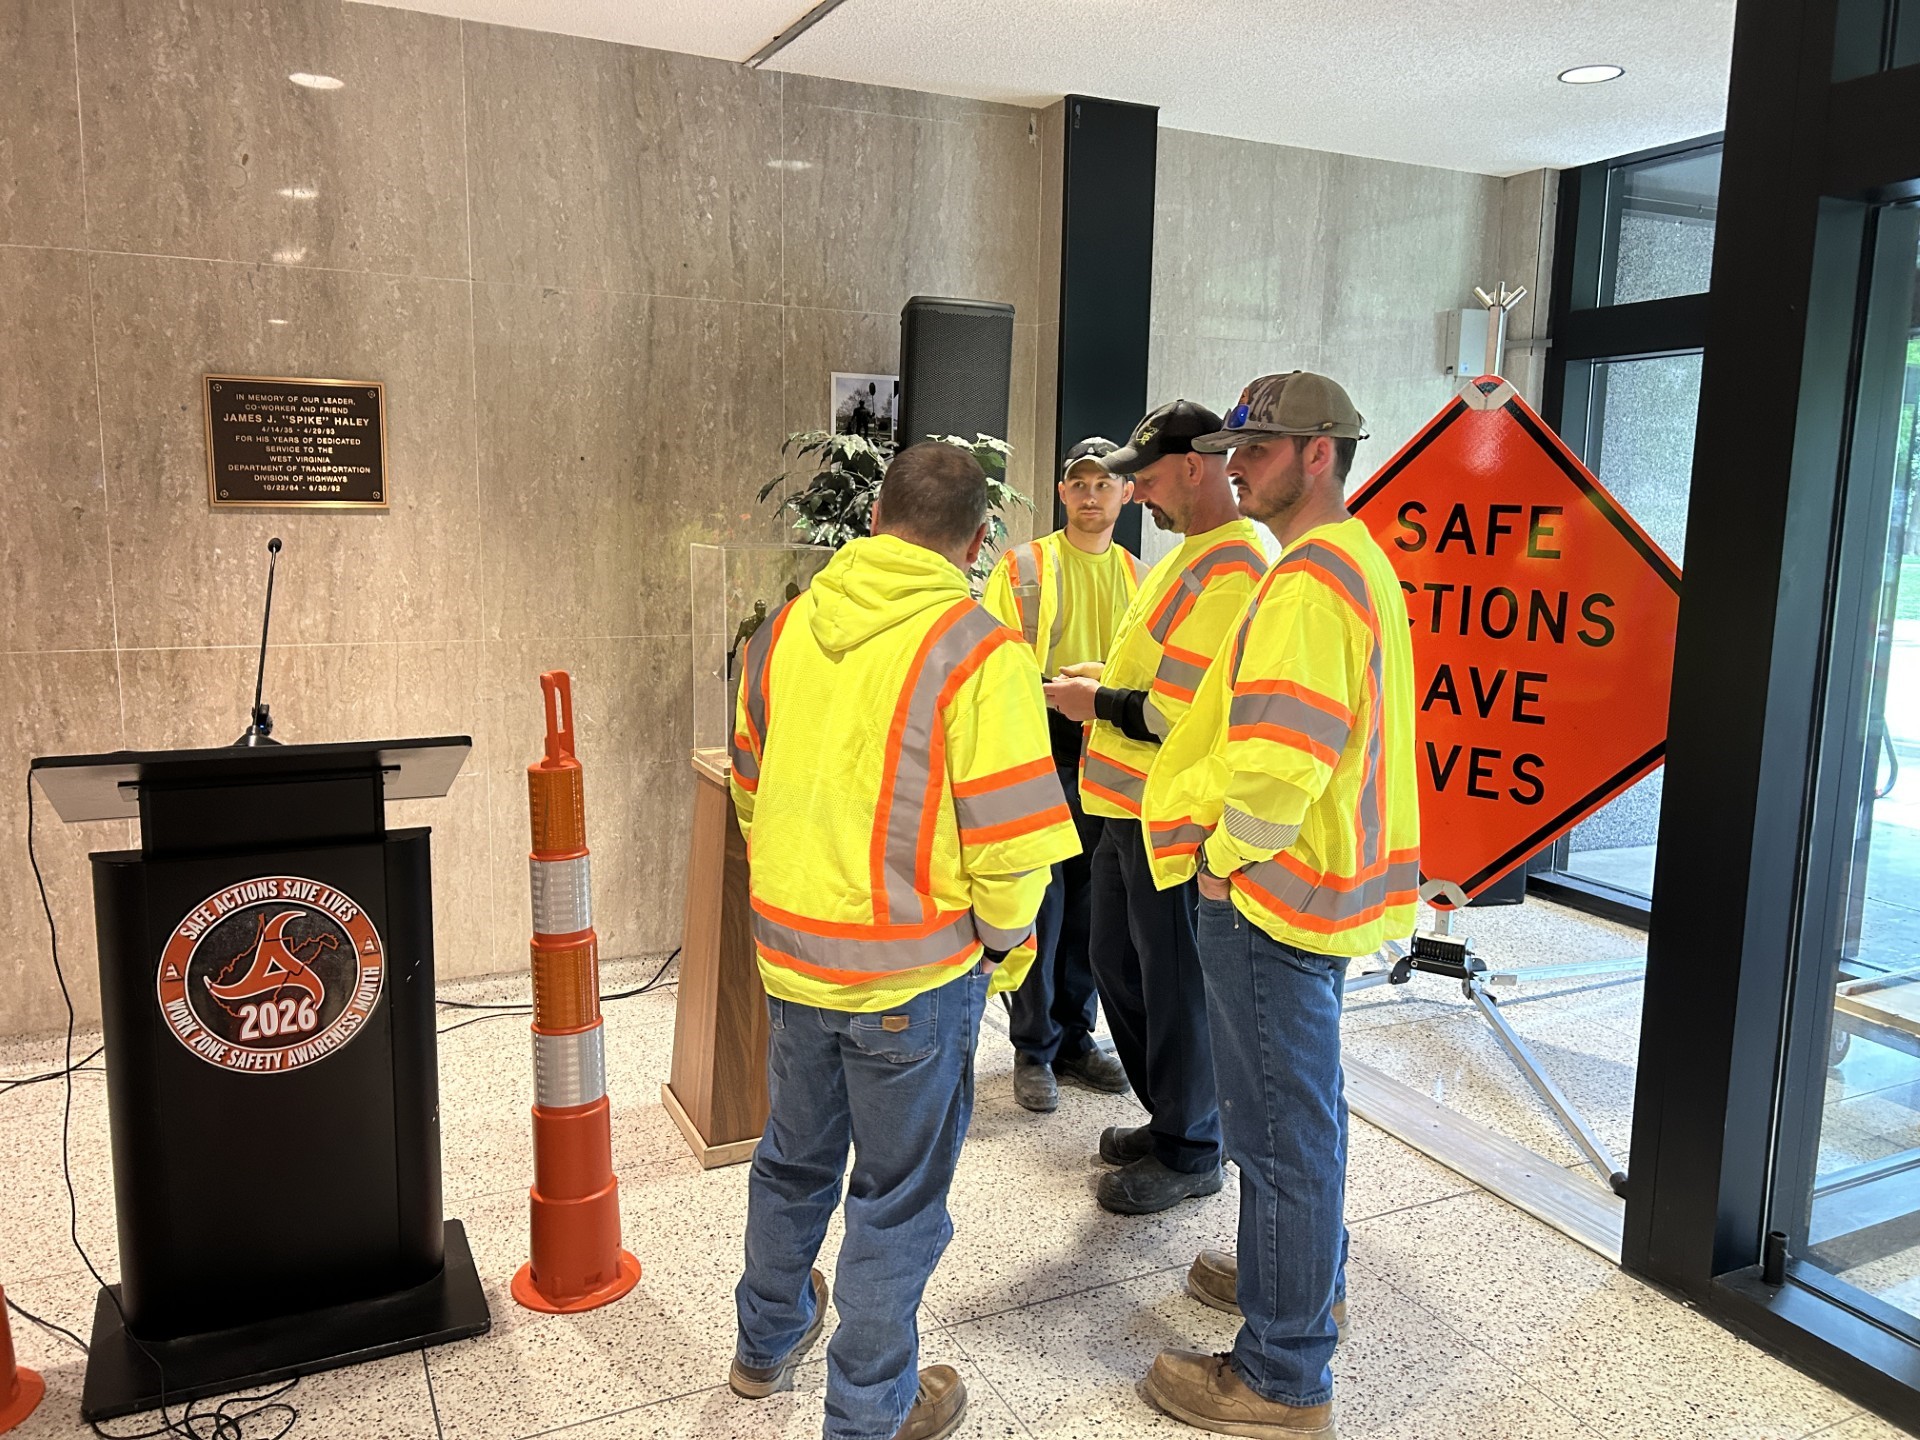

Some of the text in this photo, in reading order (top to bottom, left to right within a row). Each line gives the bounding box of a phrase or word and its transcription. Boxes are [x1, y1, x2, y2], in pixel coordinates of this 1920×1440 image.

[247, 394, 285, 402] MEMORY
[302, 396, 320, 404] OUR
[322, 397, 356, 405] LEADER,
[245, 404, 296, 412] CO-WORKER
[319, 406, 348, 414] FRIEND
[223, 413, 262, 423] JAMES
[267, 415, 277, 423] J.
[334, 417, 370, 426] HALEY
[272, 436, 300, 444] YEARS
[317, 437, 361, 445] DEDICATED
[265, 445, 300, 453] SERVICE
[228, 464, 283, 472] DEPARTMENT
[301, 465, 371, 473] TRANSPORTATION
[254, 474, 289, 482] DIVISION
[307, 475, 348, 483] HIGHWAYS
[1393, 500, 1563, 560] SAFE
[1420, 663, 1548, 725] AVE
[1414, 739, 1545, 806] VES
[179, 880, 359, 941] SAFE ACTIONS SAVE LIVES
[165, 966, 380, 1070] WORK ZONE SAFETY AWARENESS MONTH
[239, 996, 318, 1041] 2026
